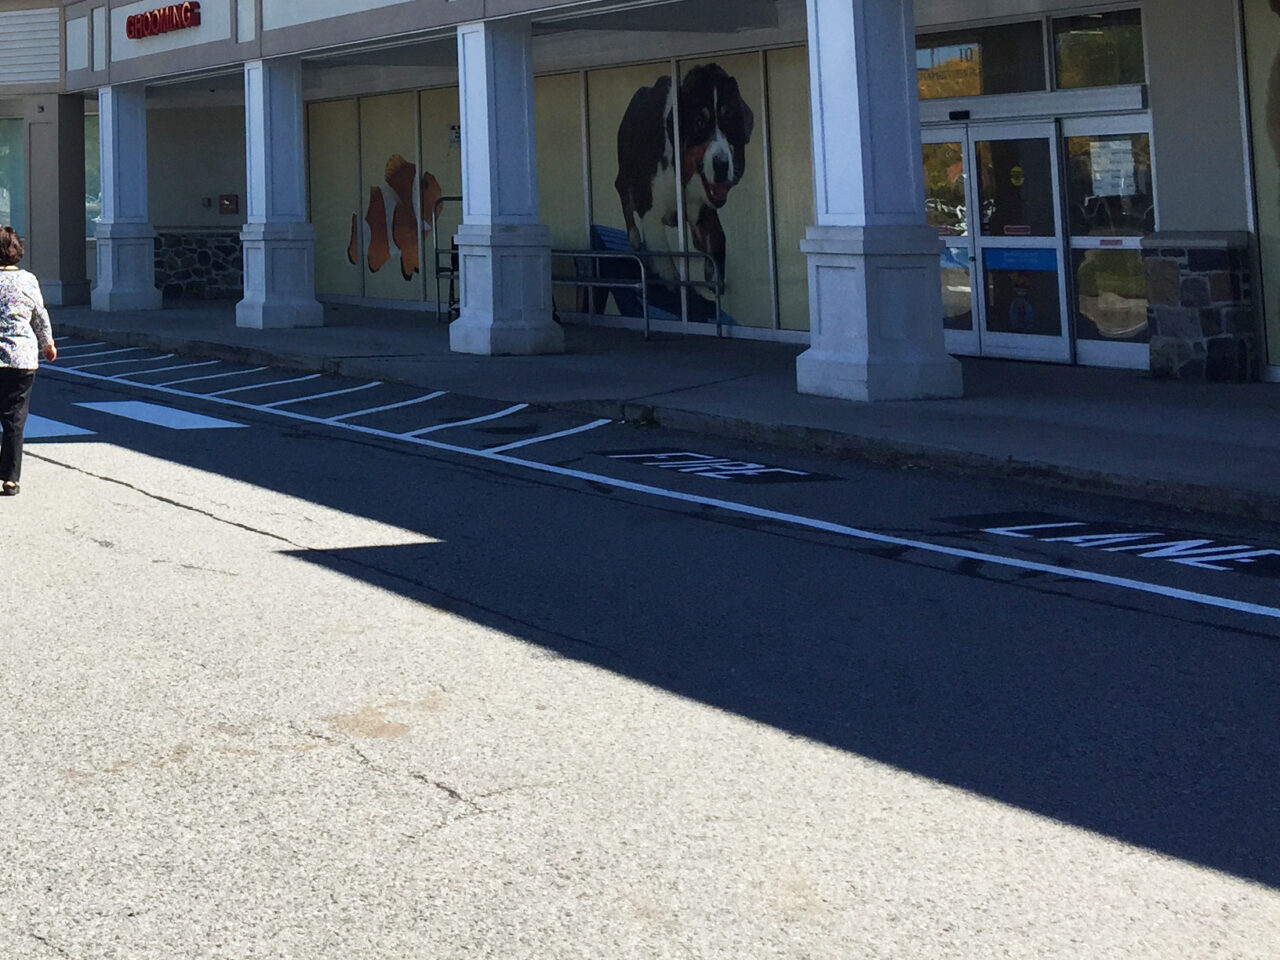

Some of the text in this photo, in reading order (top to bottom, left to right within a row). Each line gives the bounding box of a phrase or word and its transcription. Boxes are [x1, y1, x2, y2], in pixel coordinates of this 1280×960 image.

[126, 1, 201, 39] GROOMING
[608, 452, 809, 480] FIRE
[979, 522, 1280, 571] LANE
